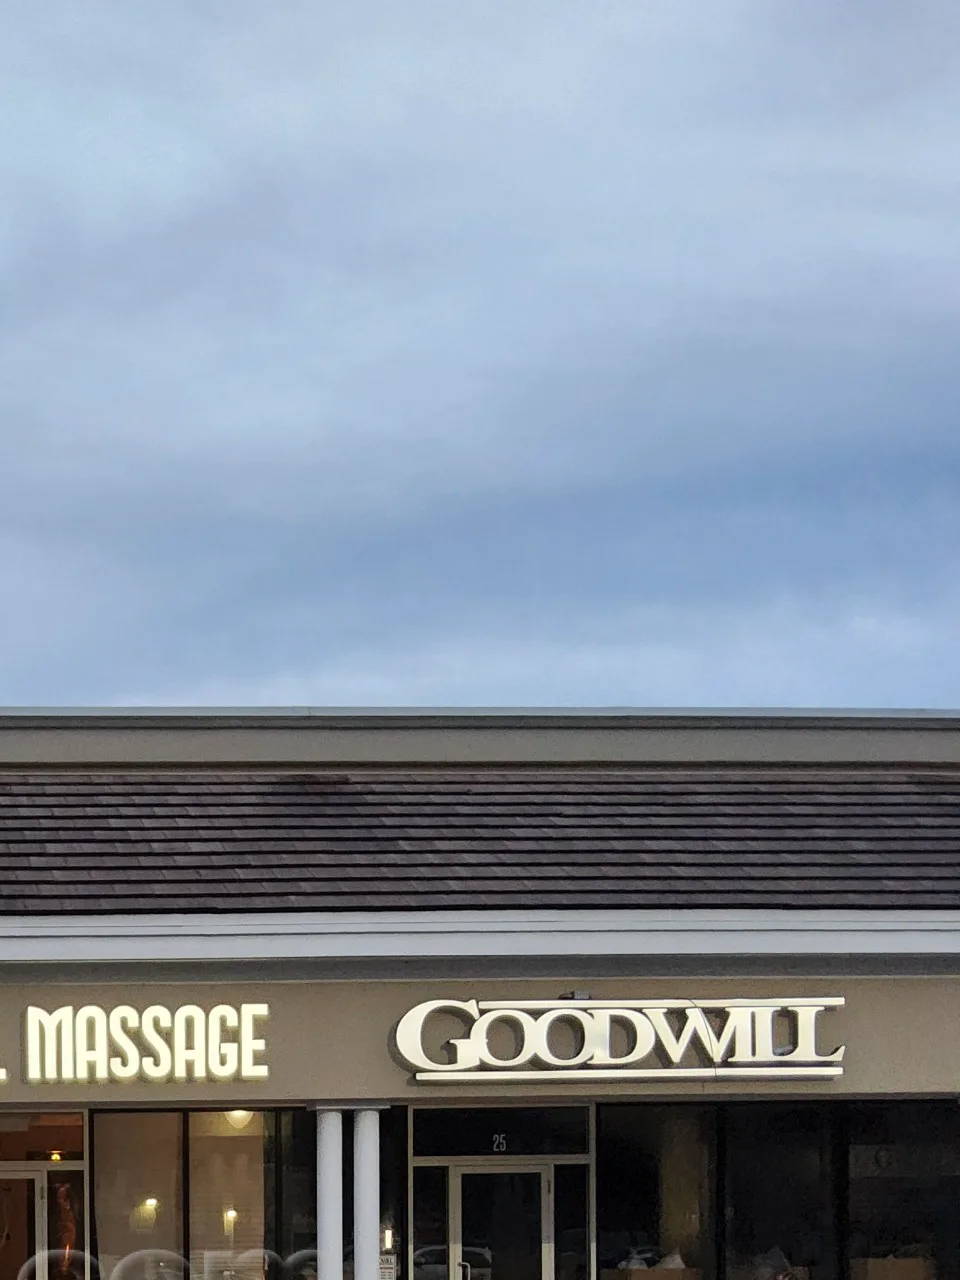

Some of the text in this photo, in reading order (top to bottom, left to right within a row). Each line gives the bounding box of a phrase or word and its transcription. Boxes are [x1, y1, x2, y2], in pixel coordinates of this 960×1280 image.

[26, 1003, 270, 1080] MASSAGE
[395, 999, 846, 1071] GOODWILL
[492, 1133, 507, 1151] 25
